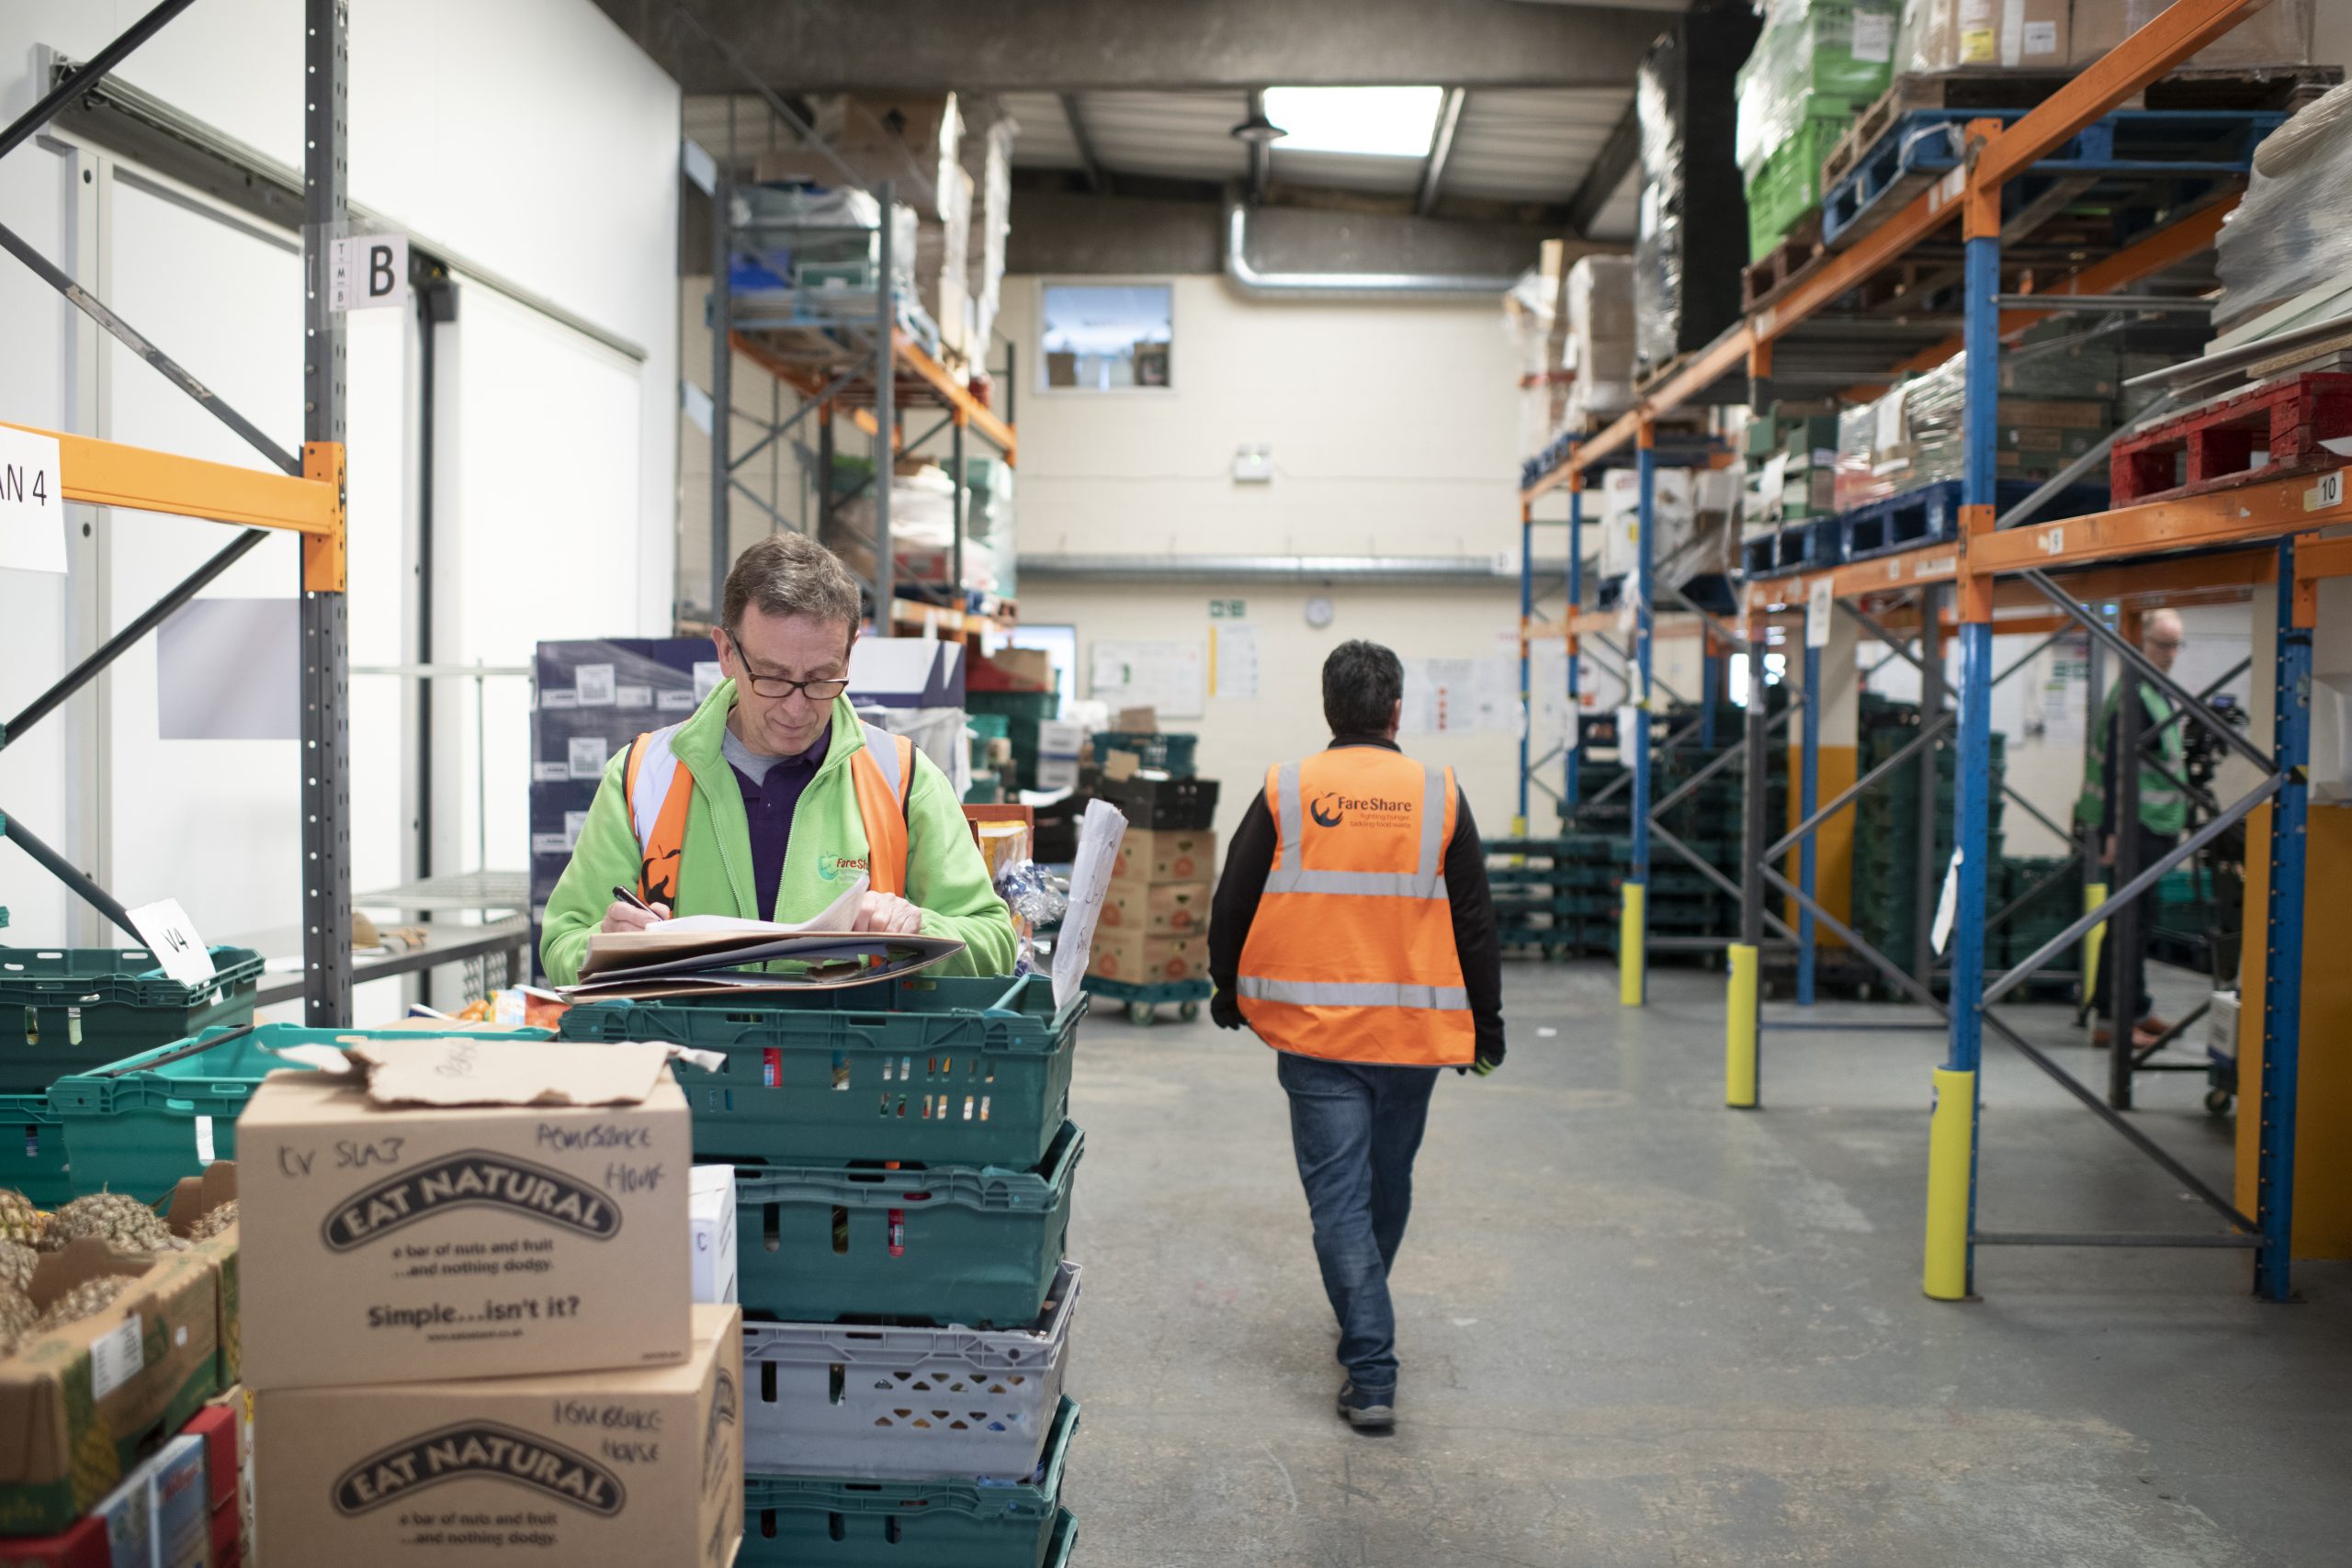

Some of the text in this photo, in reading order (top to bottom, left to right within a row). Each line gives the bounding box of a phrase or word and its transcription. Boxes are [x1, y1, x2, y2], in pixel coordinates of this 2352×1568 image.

[338, 243, 345, 254] T
[337, 267, 345, 278] M
[369, 245, 395, 297] B
[33, 469, 47, 506] 4
[2322, 476, 2336, 502] 10
[1338, 795, 1412, 812] FareShare
[161, 928, 189, 953] V4
[340, 1164, 601, 1237] EAT NATURAL
[406, 1244, 432, 1258] bar
[435, 1242, 450, 1256] of
[455, 1241, 487, 1256] nuts
[491, 1240, 519, 1254] and
[522, 1238, 554, 1253] fruit
[442, 1259, 500, 1278] nothing
[548, 1295, 580, 1319] it?
[351, 1435, 606, 1506] EAT NATURAL
[413, 1512, 435, 1527] bar
[440, 1511, 456, 1526] of
[460, 1512, 492, 1527] nuts
[495, 1511, 524, 1526] and
[526, 1510, 558, 1526] fruit
[447, 1530, 503, 1547] nothing
